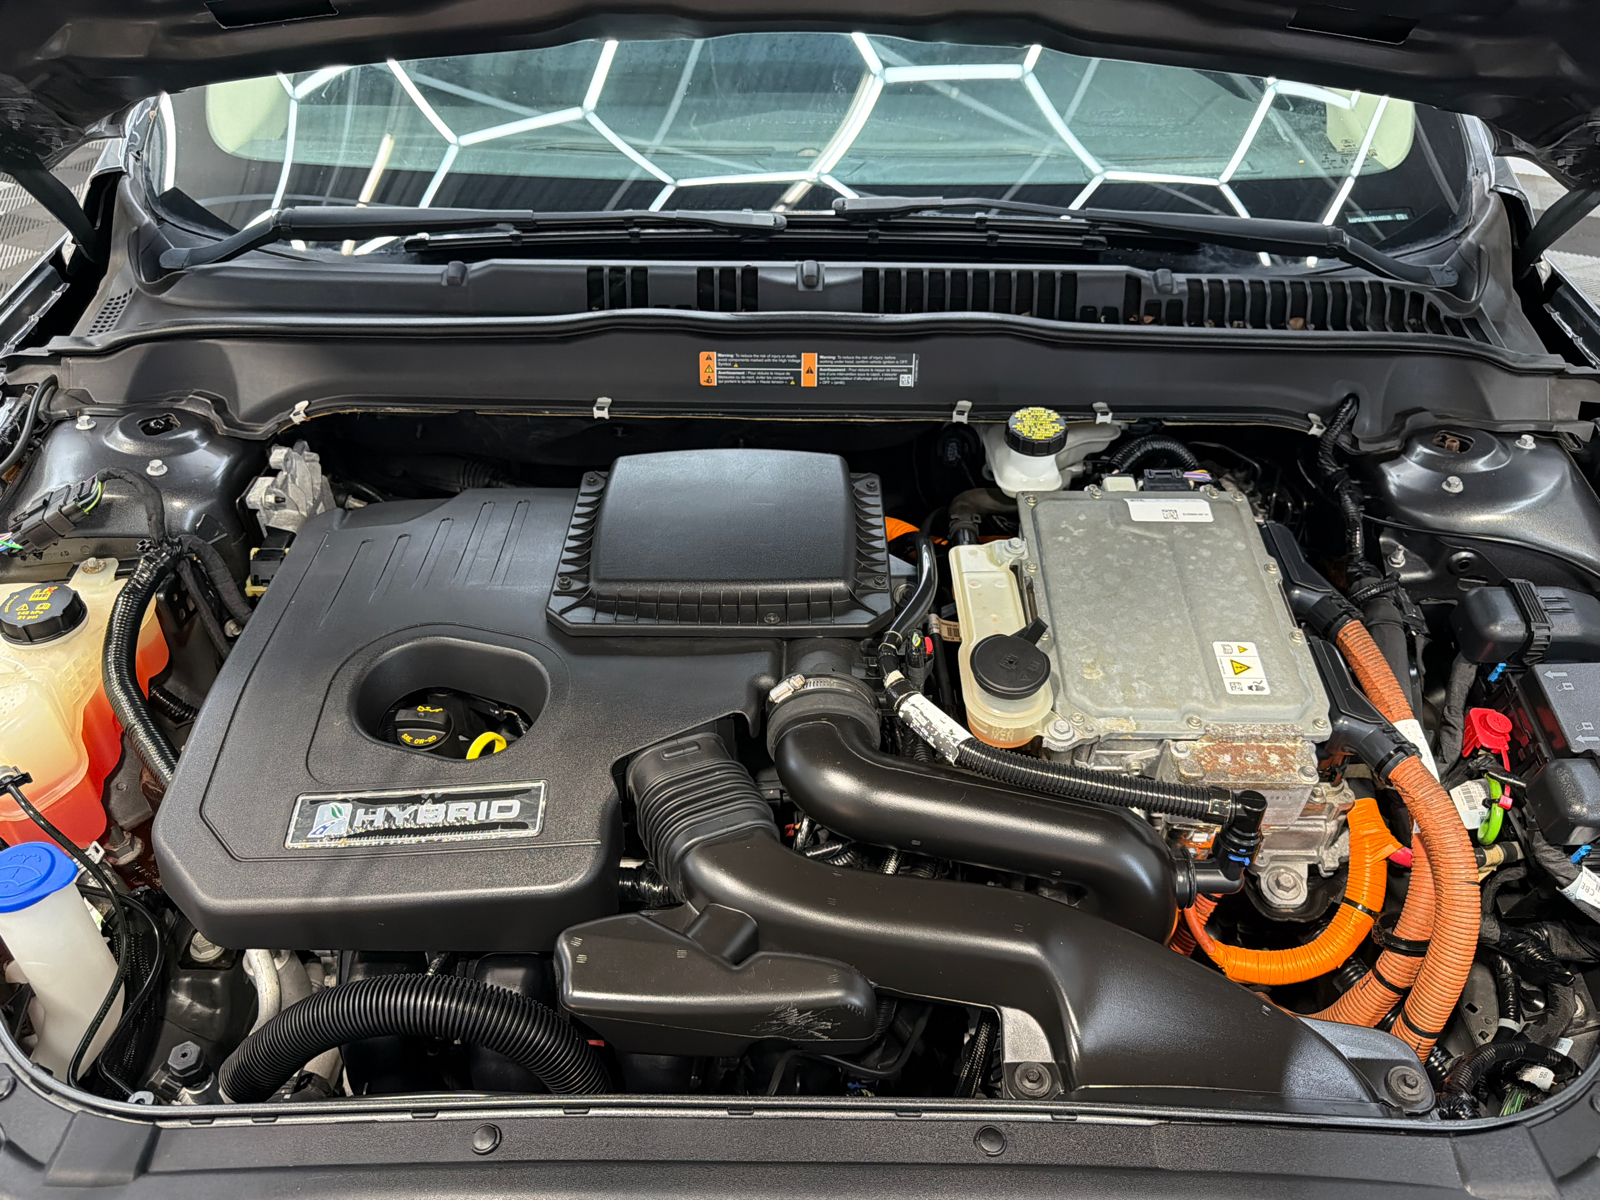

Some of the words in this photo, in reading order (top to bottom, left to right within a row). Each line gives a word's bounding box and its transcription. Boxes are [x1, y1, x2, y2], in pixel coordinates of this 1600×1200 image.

[402, 733, 413, 742] SAE
[414, 735, 437, 744] 0W-20
[354, 800, 521, 828] HYBRID
